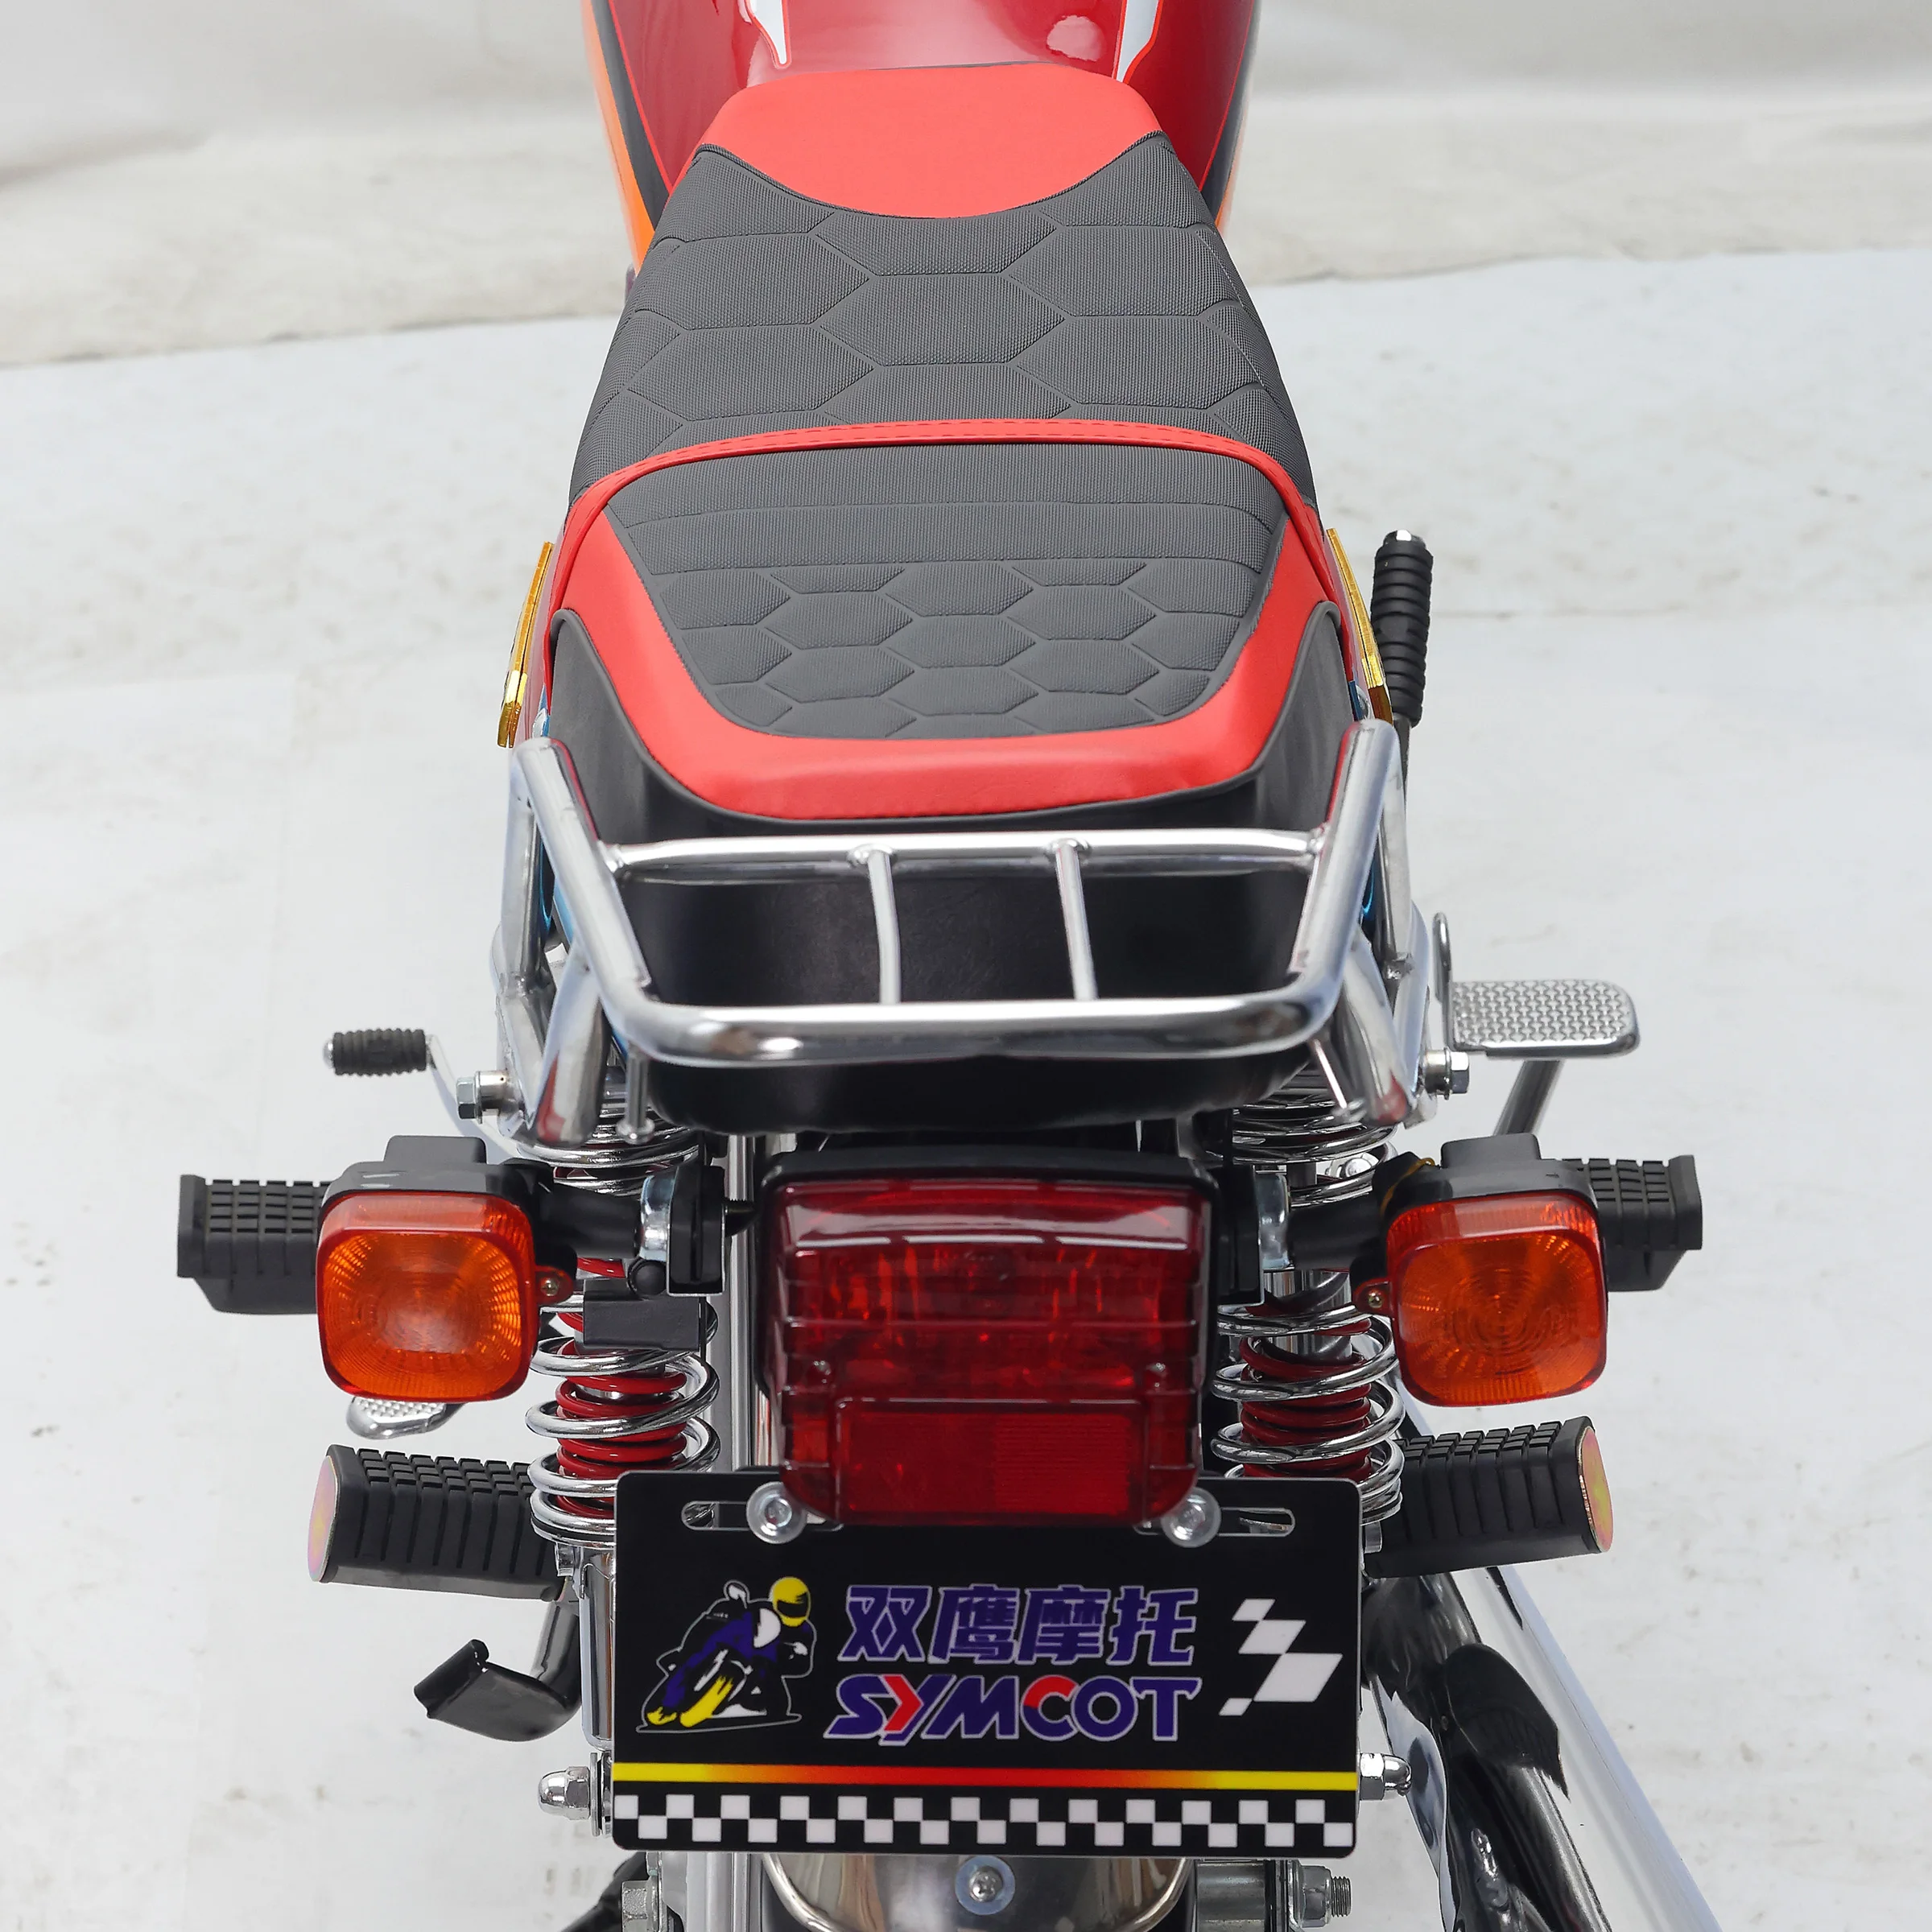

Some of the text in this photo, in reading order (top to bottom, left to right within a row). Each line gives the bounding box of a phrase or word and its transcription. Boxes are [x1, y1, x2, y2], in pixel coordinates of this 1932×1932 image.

[838, 1583, 1199, 1666] 双鹰摩托
[823, 1674, 1203, 1746] SYMCOT
